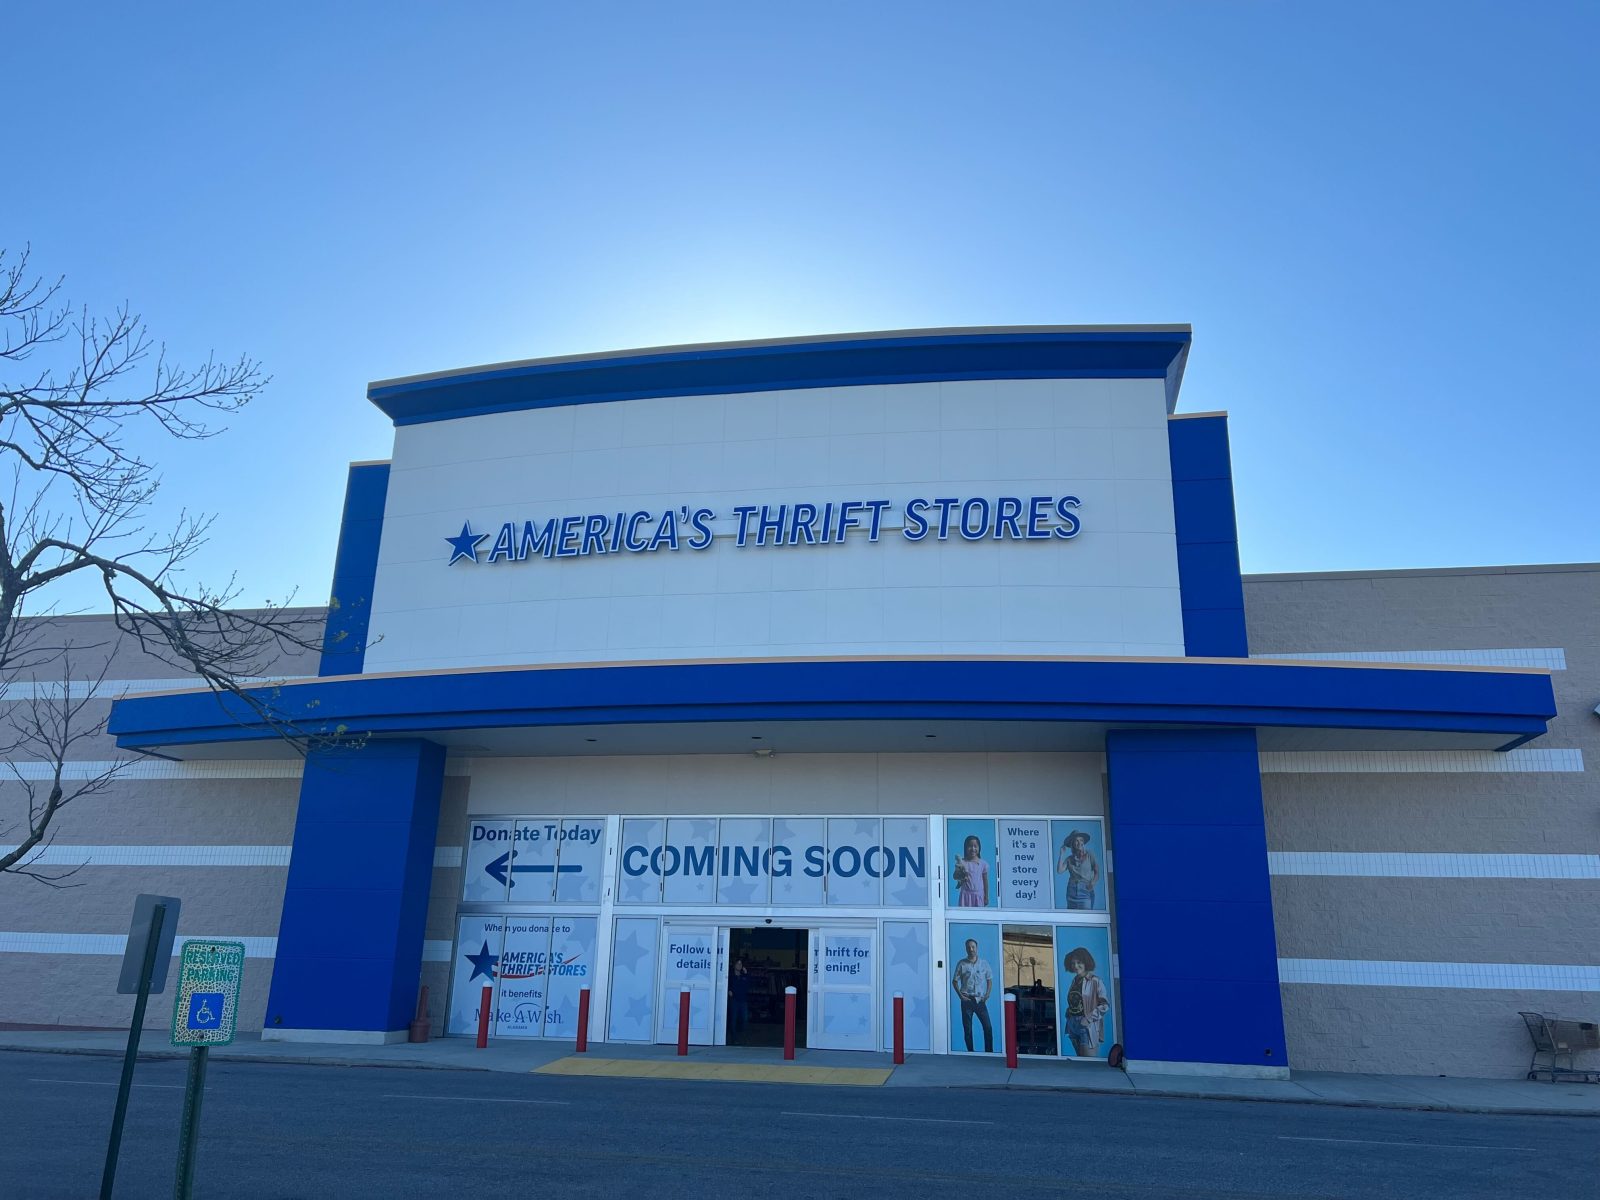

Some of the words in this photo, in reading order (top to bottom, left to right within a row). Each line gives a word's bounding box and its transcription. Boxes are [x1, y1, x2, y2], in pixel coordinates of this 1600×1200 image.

[486, 504, 716, 563] AMERICA'S
[733, 498, 891, 547] THRIFT
[903, 494, 1082, 541] STORES
[472, 825, 540, 841] Donate
[544, 824, 602, 844] Today
[1007, 827, 1040, 836] Where
[1012, 839, 1028, 849] it's
[622, 844, 793, 878] COMING
[803, 845, 926, 878] SOON
[1012, 865, 1038, 874] store
[1012, 879, 1039, 888] every
[1015, 889, 1037, 901] day!
[484, 923, 511, 932] When
[512, 925, 527, 934] you
[562, 924, 571, 933] to
[669, 943, 705, 954] Follow
[825, 946, 850, 957] hrift
[853, 947, 870, 958] for
[185, 949, 240, 965] RESERVED
[501, 951, 564, 964] AMERICA'S
[501, 963, 541, 975] THRIFT
[543, 964, 587, 976] STORES
[676, 958, 711, 969] details
[825, 961, 860, 975] ening!
[186, 968, 235, 982] PARKING
[501, 989, 506, 998] it
[508, 989, 543, 999] benefits
